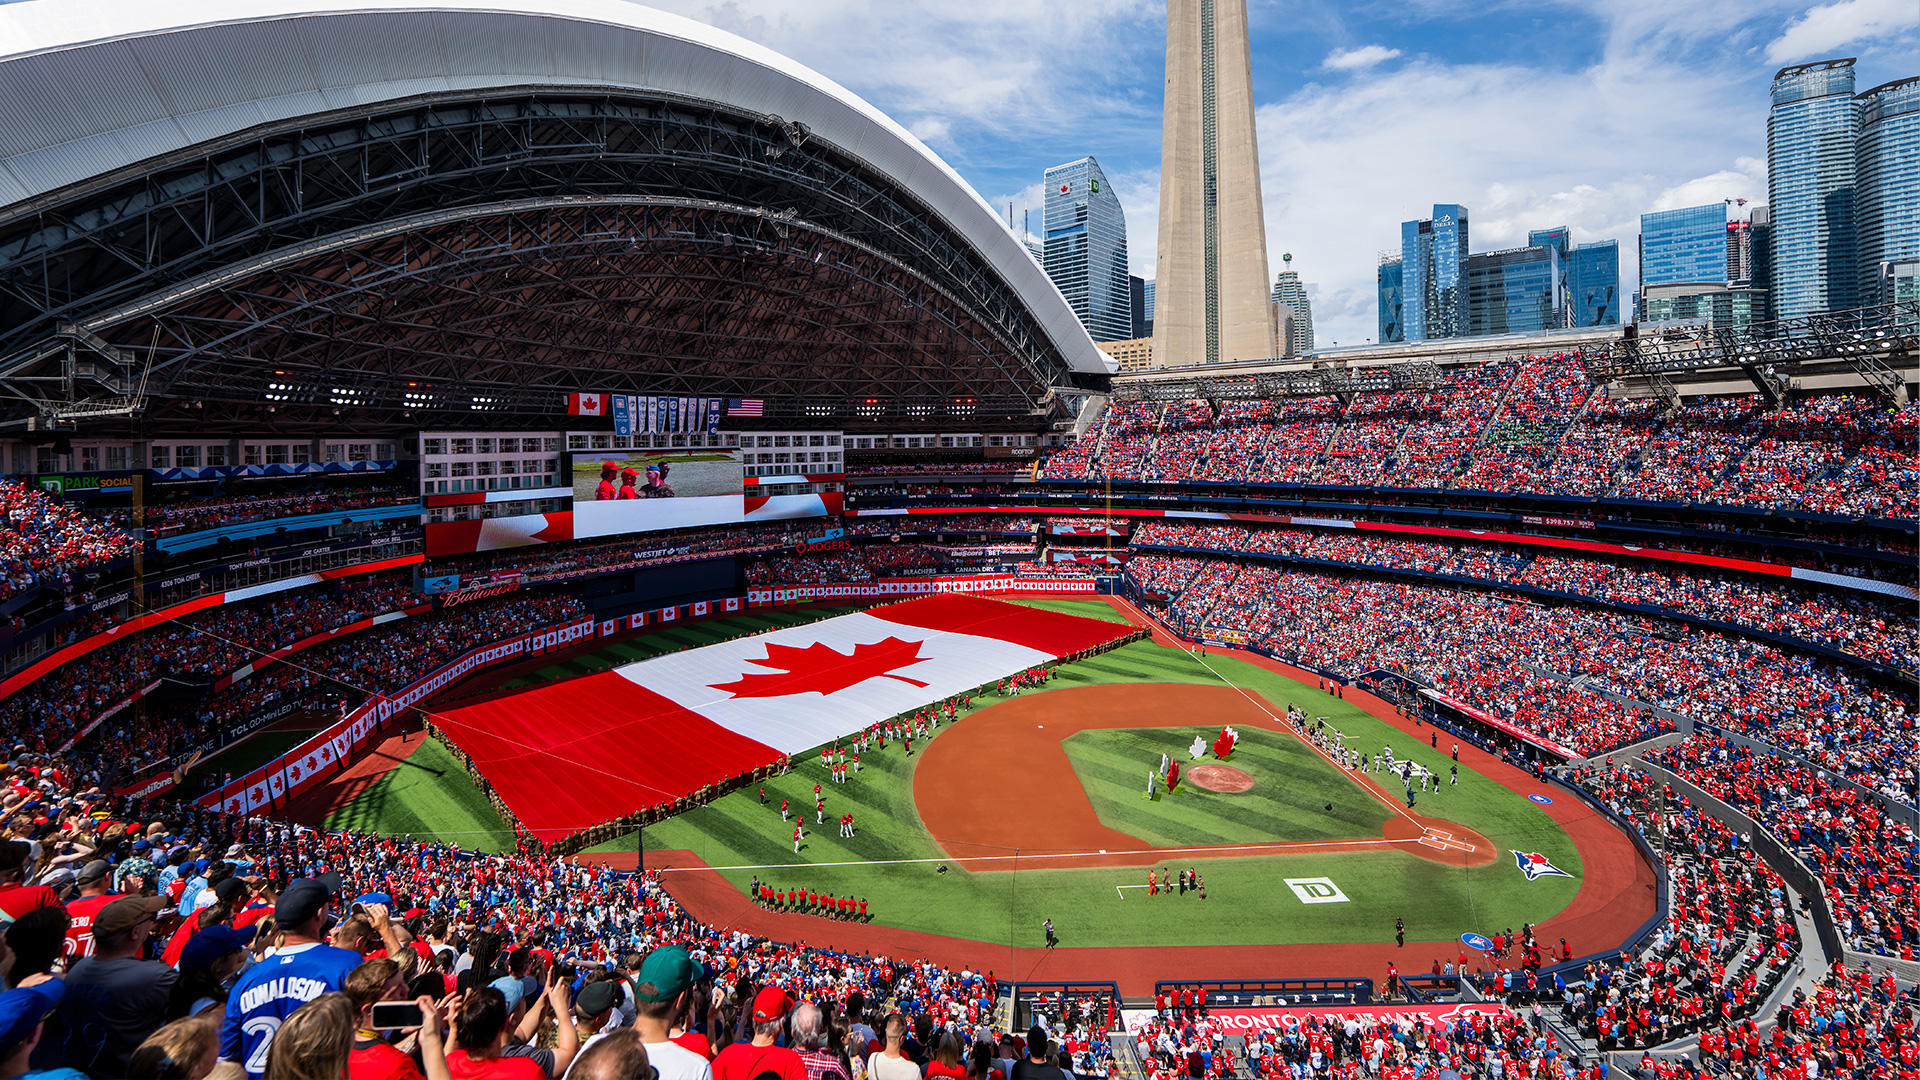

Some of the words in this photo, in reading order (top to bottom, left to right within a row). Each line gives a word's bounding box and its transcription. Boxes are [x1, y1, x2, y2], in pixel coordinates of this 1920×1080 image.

[709, 414, 720, 424] 32
[65, 476, 99, 489] PARK
[100, 478, 133, 487] SOCIAL
[313, 546, 331, 555] CARTER
[808, 540, 851, 551] ROGERS
[634, 549, 667, 559] WESTJET
[229, 563, 243, 571] TONY
[244, 557, 271, 568] FERNANDEZ
[186, 572, 200, 582] CHEEK
[91, 600, 109, 612] CARLOS
[109, 592, 129, 606] DELGADO
[439, 582, 522, 608] Budweiser
[171, 739, 215, 767] RTPHONE
[230, 724, 249, 738] TCL
[249, 710, 278, 729] QD-Mini
[277, 705, 292, 716] LED
[290, 699, 303, 710] TV
[129, 777, 173, 799] eautiTone
[1292, 882, 1337, 898] TD
[240, 976, 327, 1014] DONALDSON
[1204, 1014, 1301, 1030] ORONTO
[241, 1014, 286, 1074] 2
